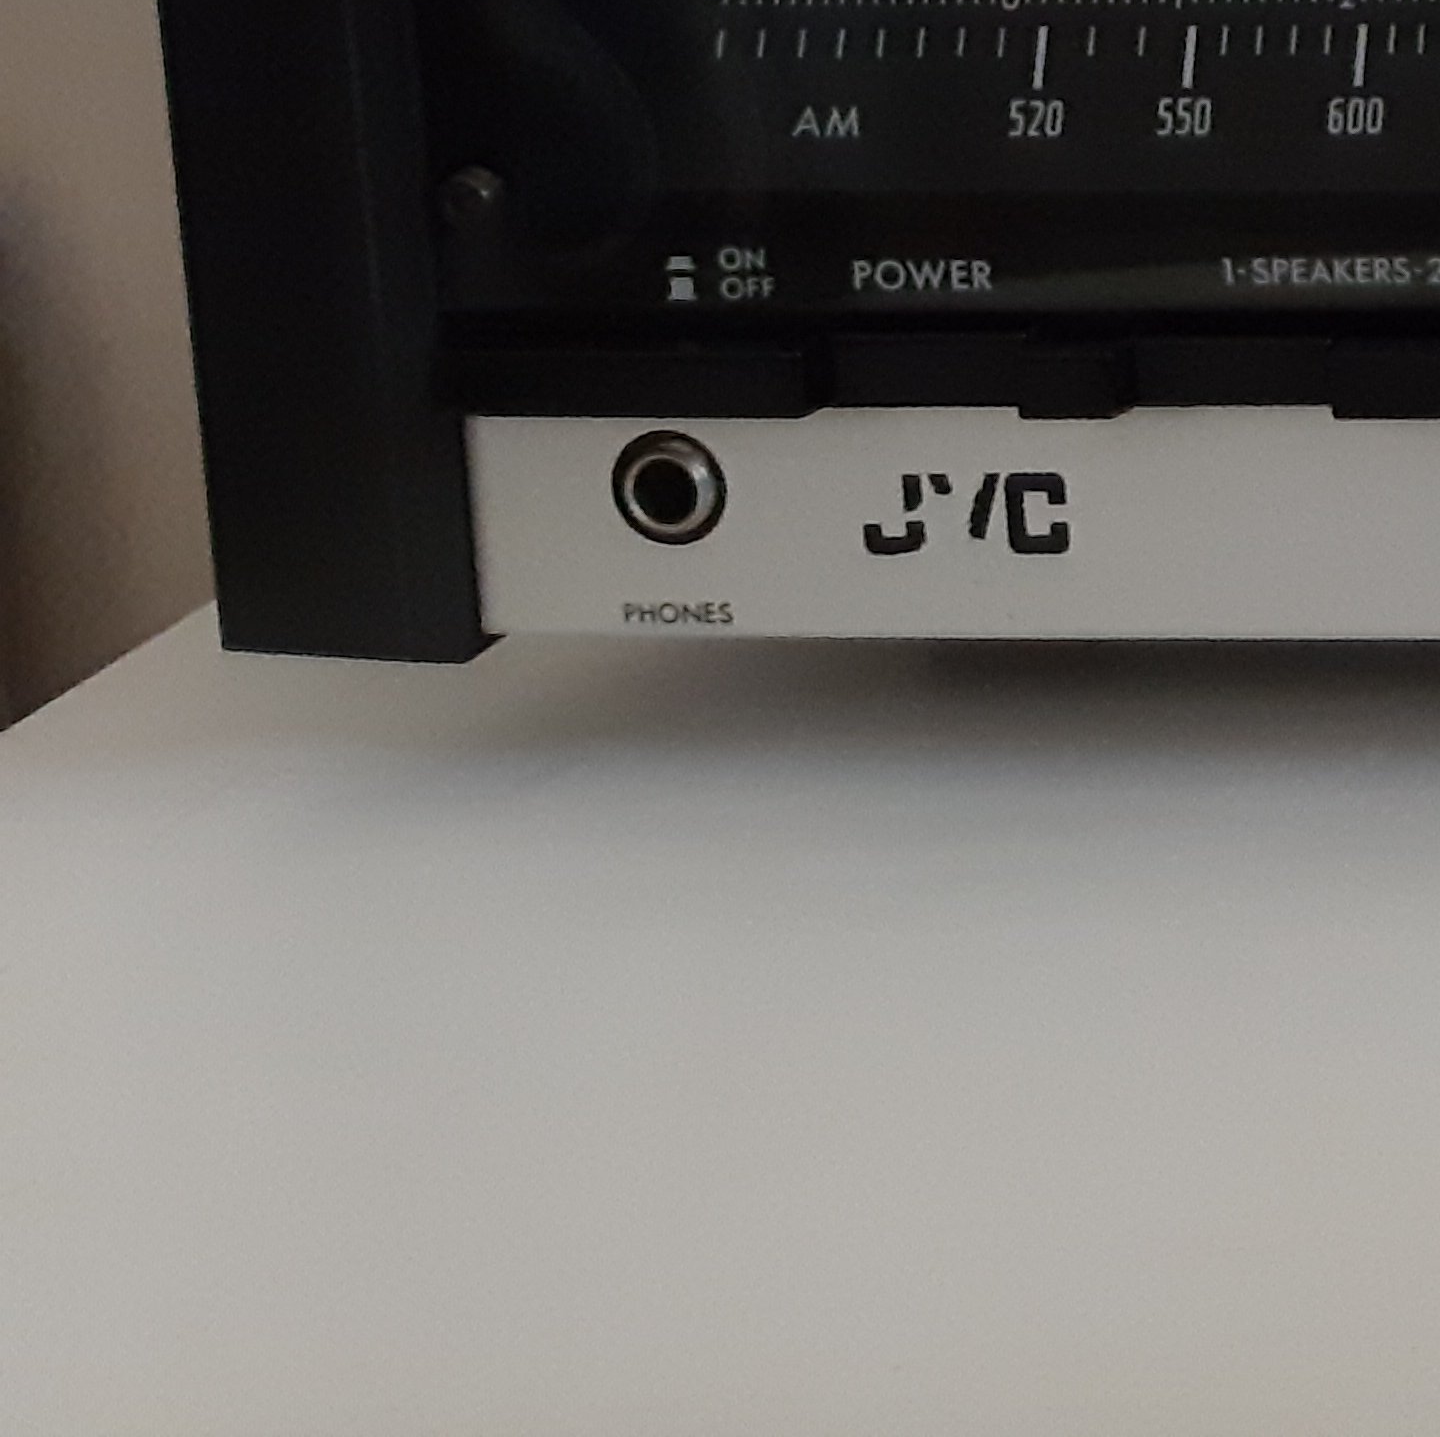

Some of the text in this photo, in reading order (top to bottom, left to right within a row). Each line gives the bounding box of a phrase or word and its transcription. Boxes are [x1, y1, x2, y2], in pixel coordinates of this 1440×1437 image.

[791, 106, 860, 138] AM
[1008, 99, 1064, 137] 520
[1156, 97, 1212, 136] 550
[1327, 97, 1384, 135] 600
[718, 247, 765, 271] ON
[719, 276, 774, 301] OFF
[852, 259, 993, 292] POWER
[623, 602, 734, 625] PHONES
